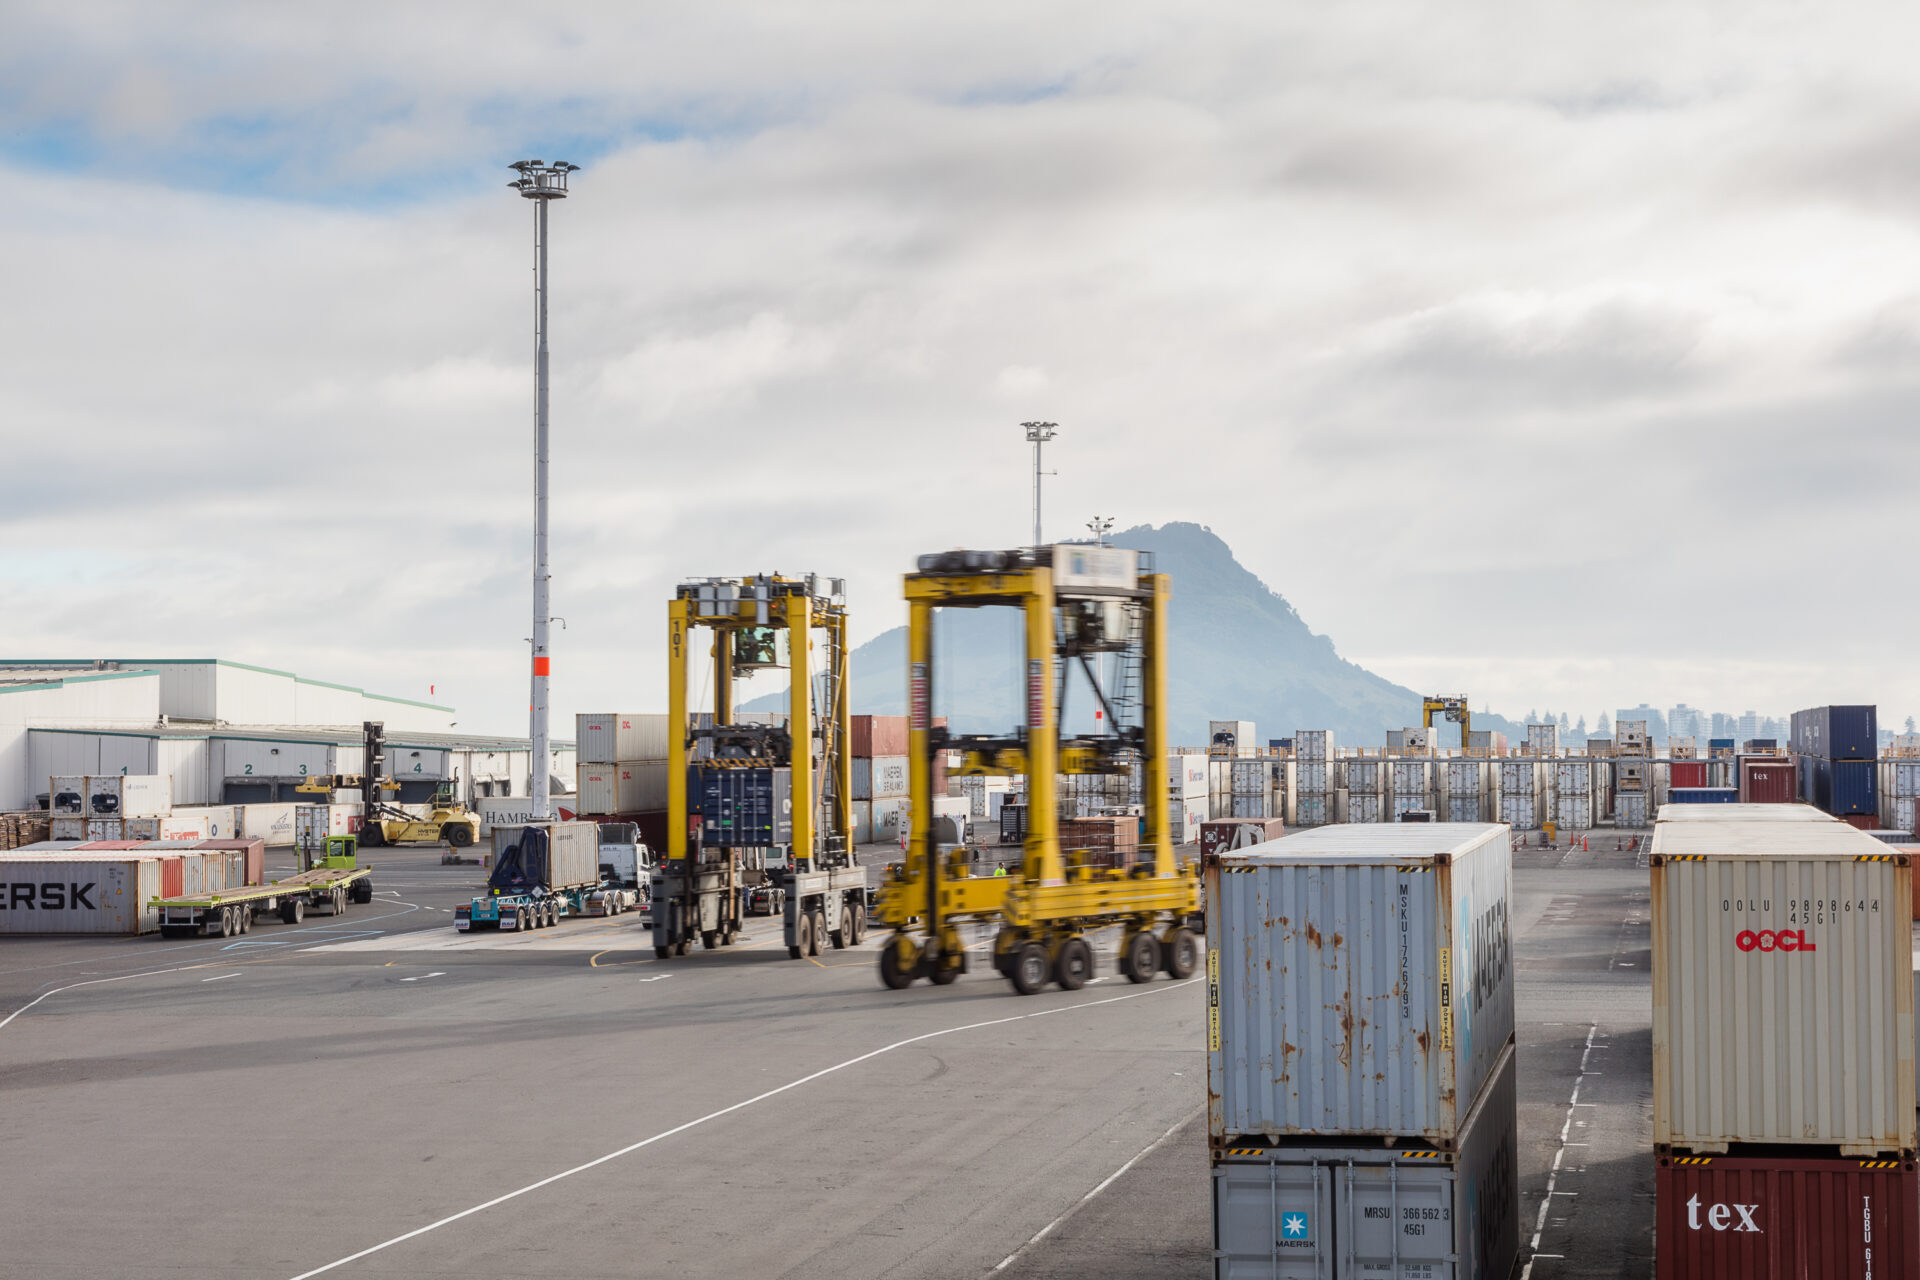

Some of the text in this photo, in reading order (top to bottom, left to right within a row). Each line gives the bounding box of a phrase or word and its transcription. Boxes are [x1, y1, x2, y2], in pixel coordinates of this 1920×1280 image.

[672, 621, 681, 658] 101
[244, 764, 253, 775] 2
[299, 764, 307, 775] 3
[413, 762, 422, 774] 4
[1753, 772, 1769, 780] tex
[485, 811, 558, 824] HAMBG
[1790, 912, 1836, 925] 45G1
[1735, 929, 1817, 952] OOCL
[1364, 1207, 1390, 1219] MRSU
[1863, 1196, 1871, 1243] TGBU
[1403, 1223, 1425, 1236] 45G1
[1275, 1240, 1316, 1248] MAERSK
